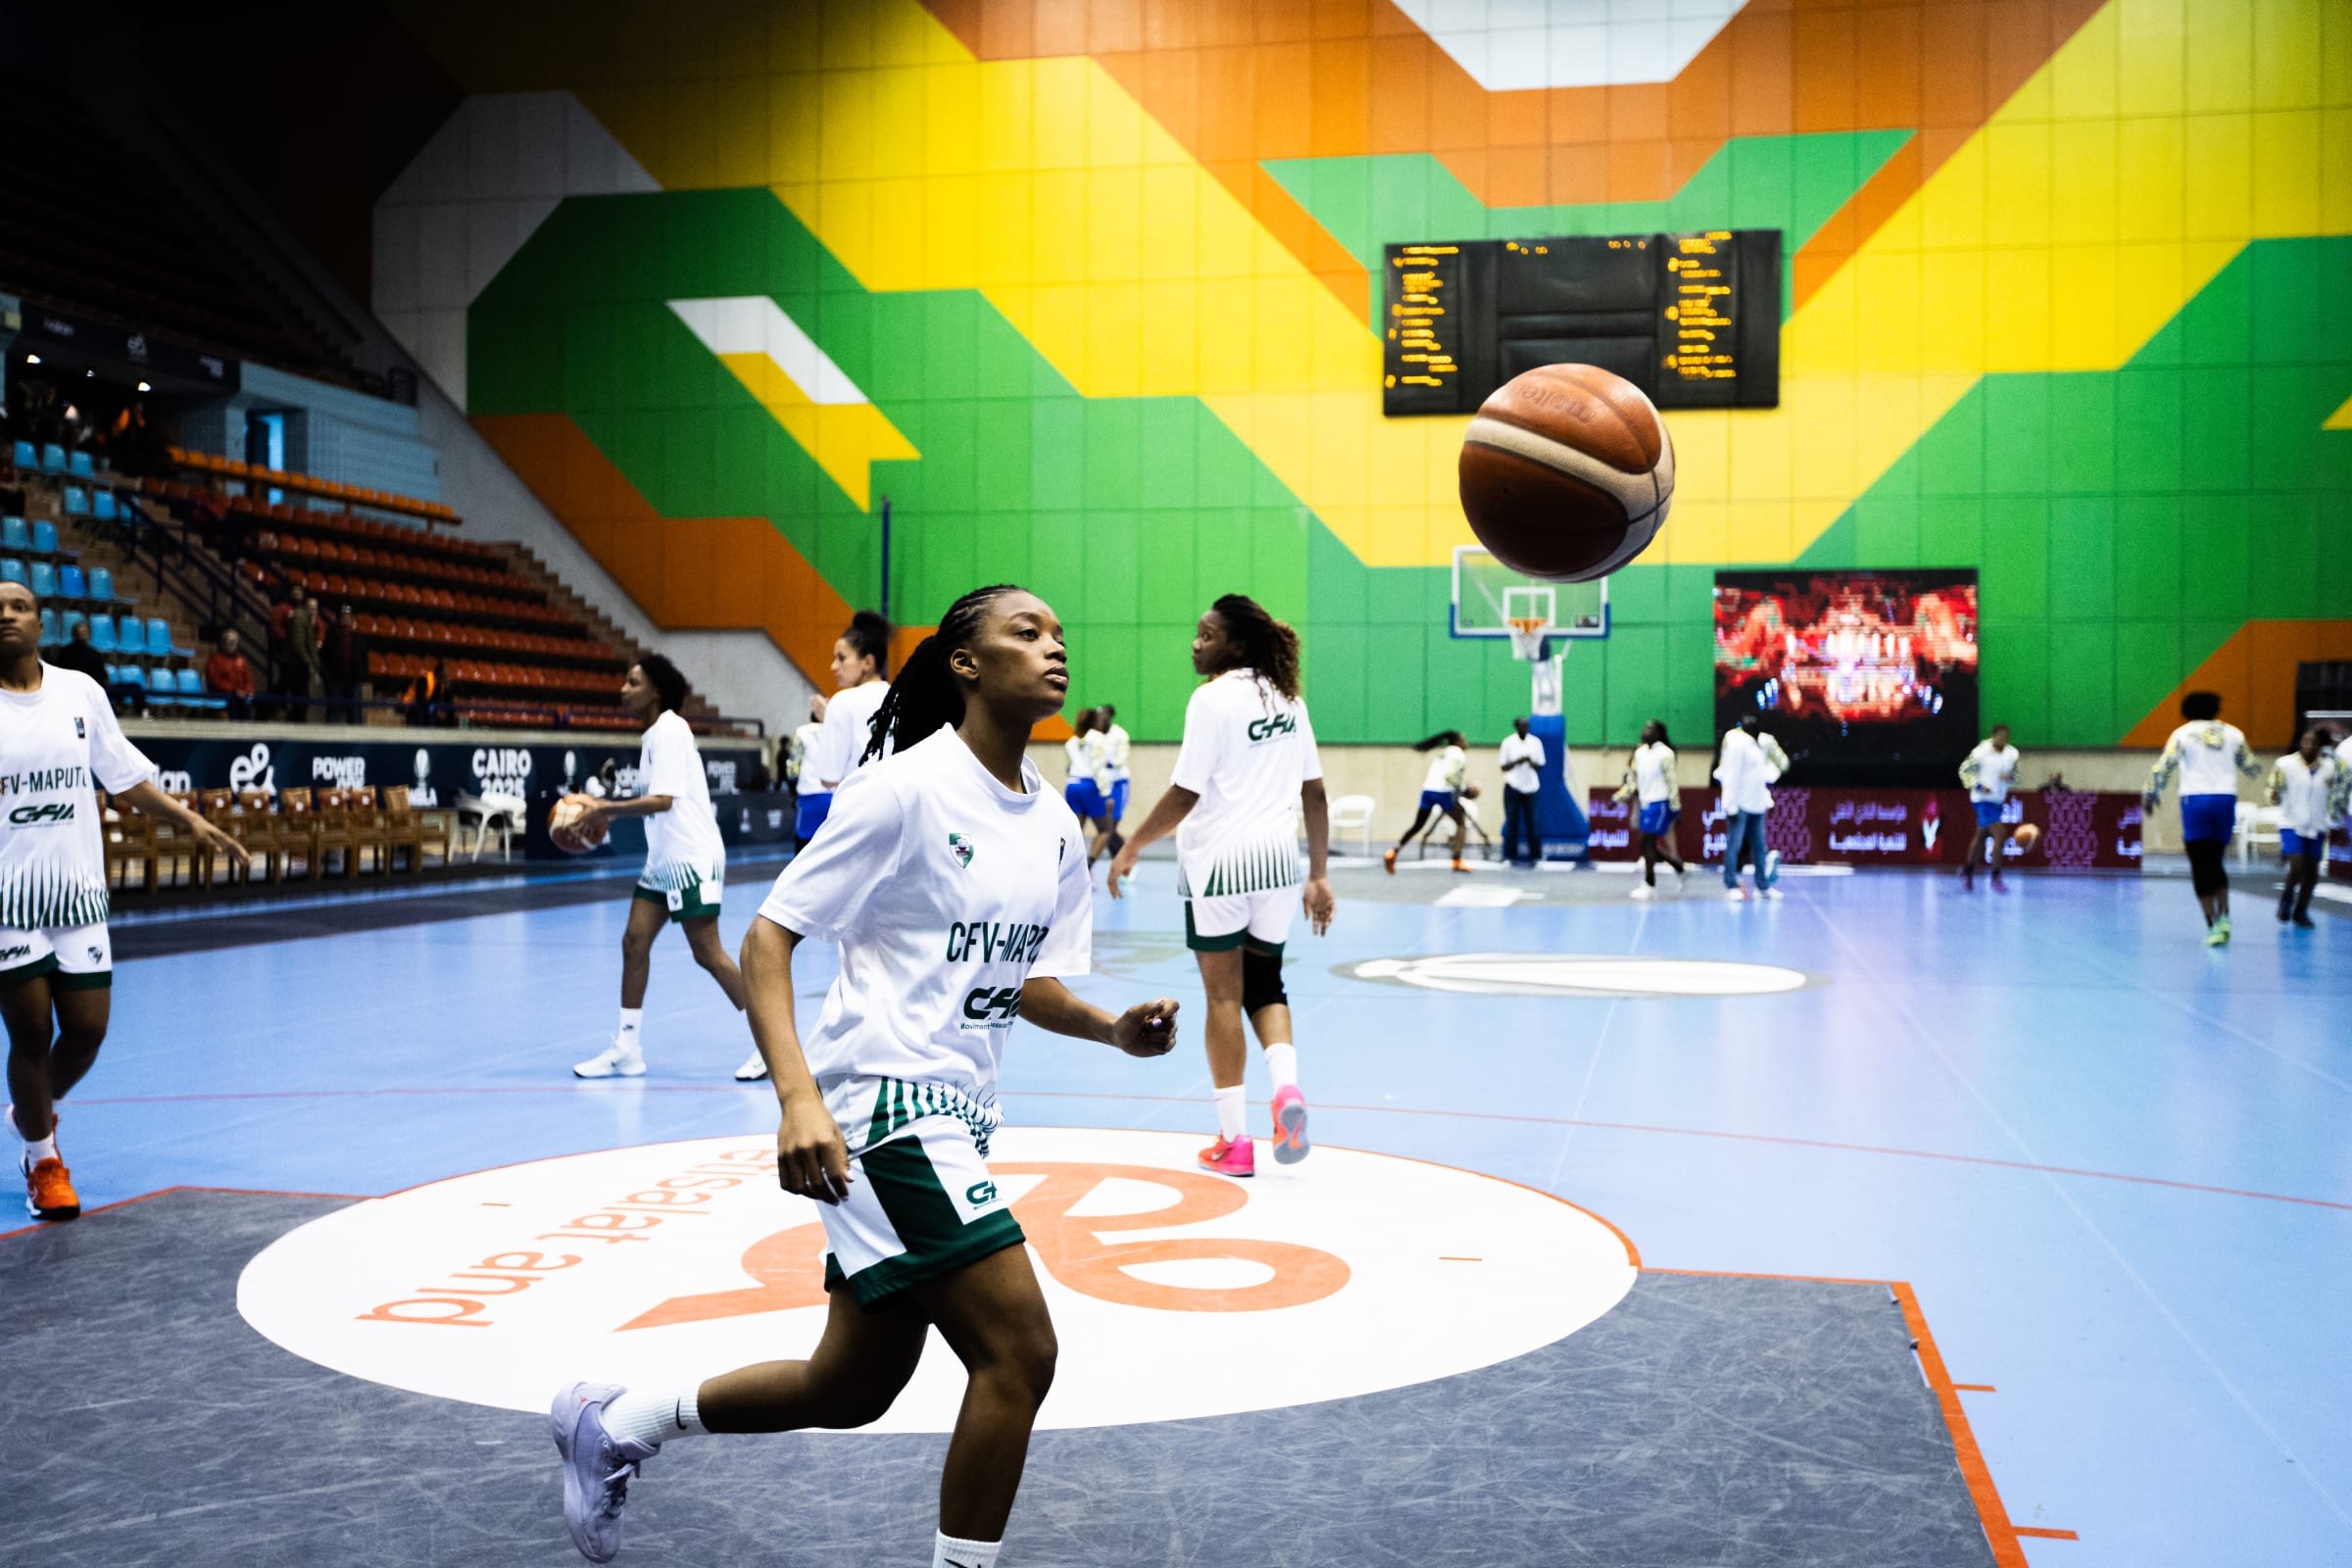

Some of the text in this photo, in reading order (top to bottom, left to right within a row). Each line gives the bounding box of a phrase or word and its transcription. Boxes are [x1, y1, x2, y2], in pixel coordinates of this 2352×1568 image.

[313, 757, 366, 780] POWER
[471, 749, 532, 779] CAIRO
[353, 1250, 584, 1327] and
